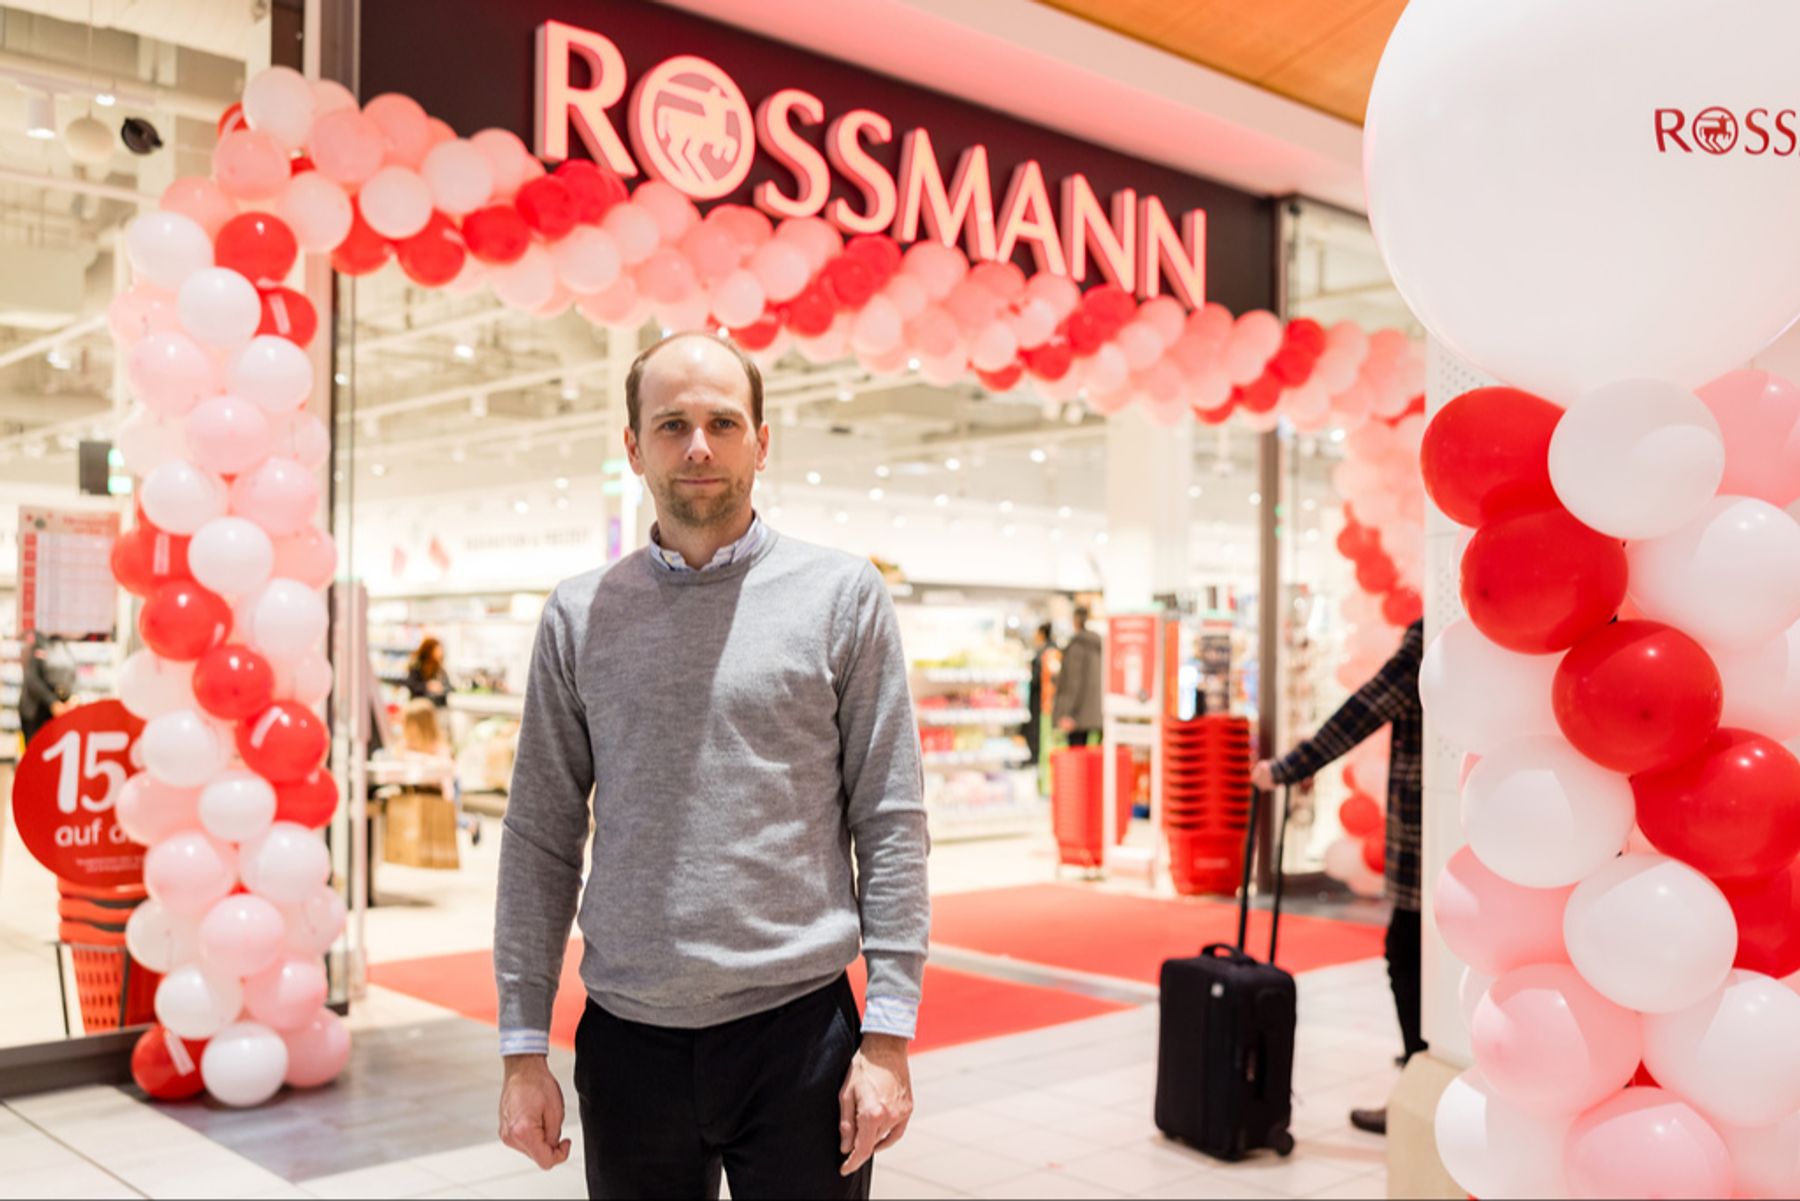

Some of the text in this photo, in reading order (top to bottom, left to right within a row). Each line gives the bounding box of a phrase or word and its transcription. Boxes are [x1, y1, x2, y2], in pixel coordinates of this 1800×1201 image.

[533, 19, 1207, 309] ROSSMANN
[1654, 106, 1800, 157] ROSS
[41, 729, 145, 814] 15
[54, 817, 103, 847] auf
